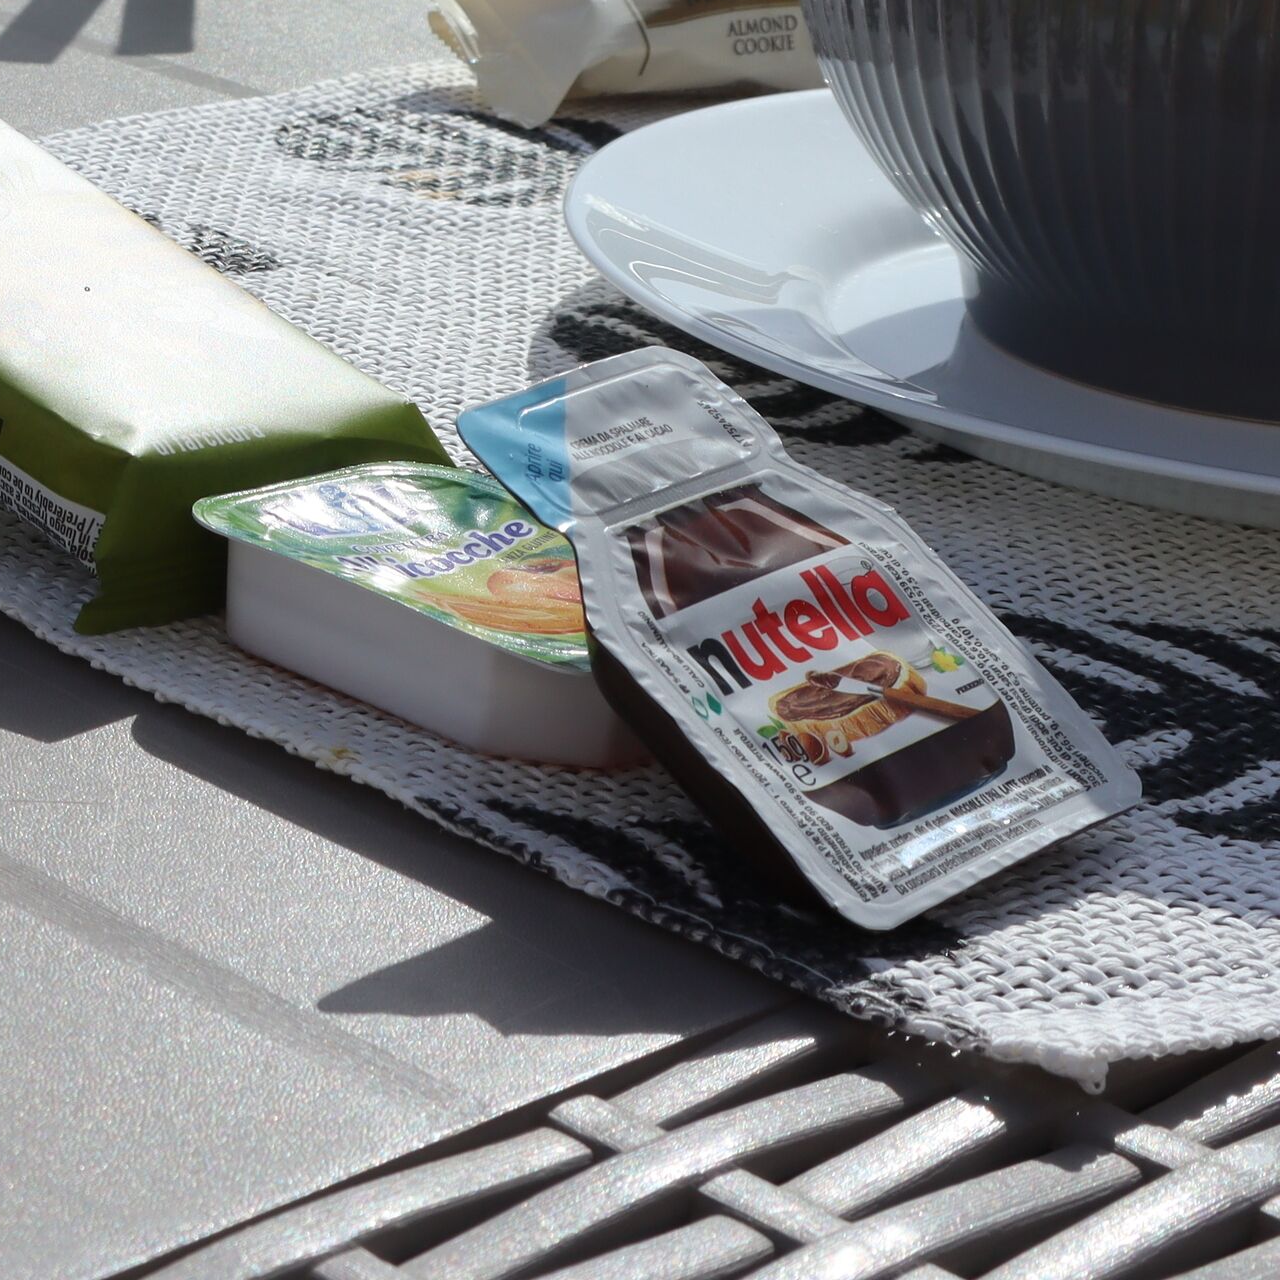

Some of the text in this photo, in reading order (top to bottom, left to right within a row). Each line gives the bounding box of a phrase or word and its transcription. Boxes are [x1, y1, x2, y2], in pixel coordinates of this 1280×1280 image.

[728, 15, 798, 37] ALMOND
[734, 34, 795, 55] COOKIE
[525, 443, 543, 483] Aprire
[546, 459, 564, 483] qui
[13, 476, 23, 491] be
[24, 484, 33, 496] to
[15, 491, 21, 500] e
[22, 496, 46, 520] fresco
[35, 491, 85, 530] Preferably
[45, 517, 75, 539] luogo
[78, 531, 89, 545] in
[686, 564, 912, 696] nutella
[982, 669, 998, 685] 100
[998, 687, 1013, 701] per
[1010, 702, 1029, 723] medi
[761, 731, 811, 767] 15g
[1027, 725, 1067, 769] nutrizionali
[1066, 769, 1091, 789] Valori
